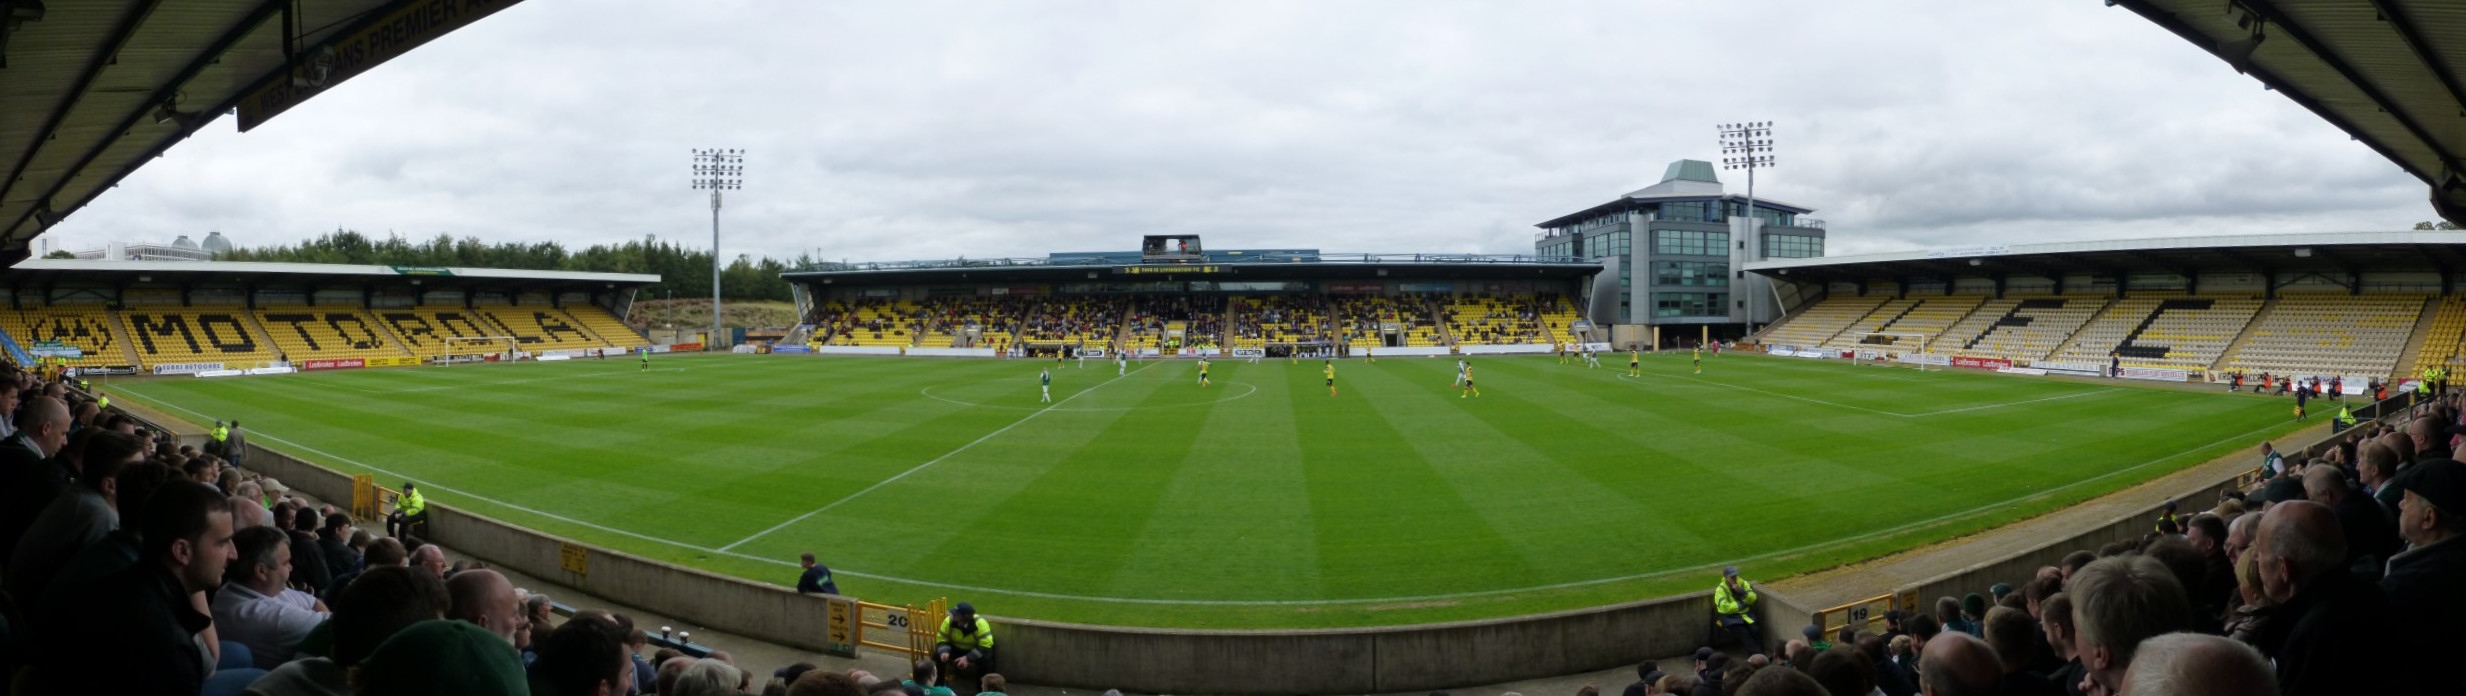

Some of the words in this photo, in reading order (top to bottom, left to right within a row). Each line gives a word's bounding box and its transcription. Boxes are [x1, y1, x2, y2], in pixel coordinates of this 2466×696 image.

[370, 0, 457, 57] PREMIER
[130, 312, 592, 355] MOTOROLA
[888, 614, 909, 628] 20
[1853, 608, 1868, 621] 19
